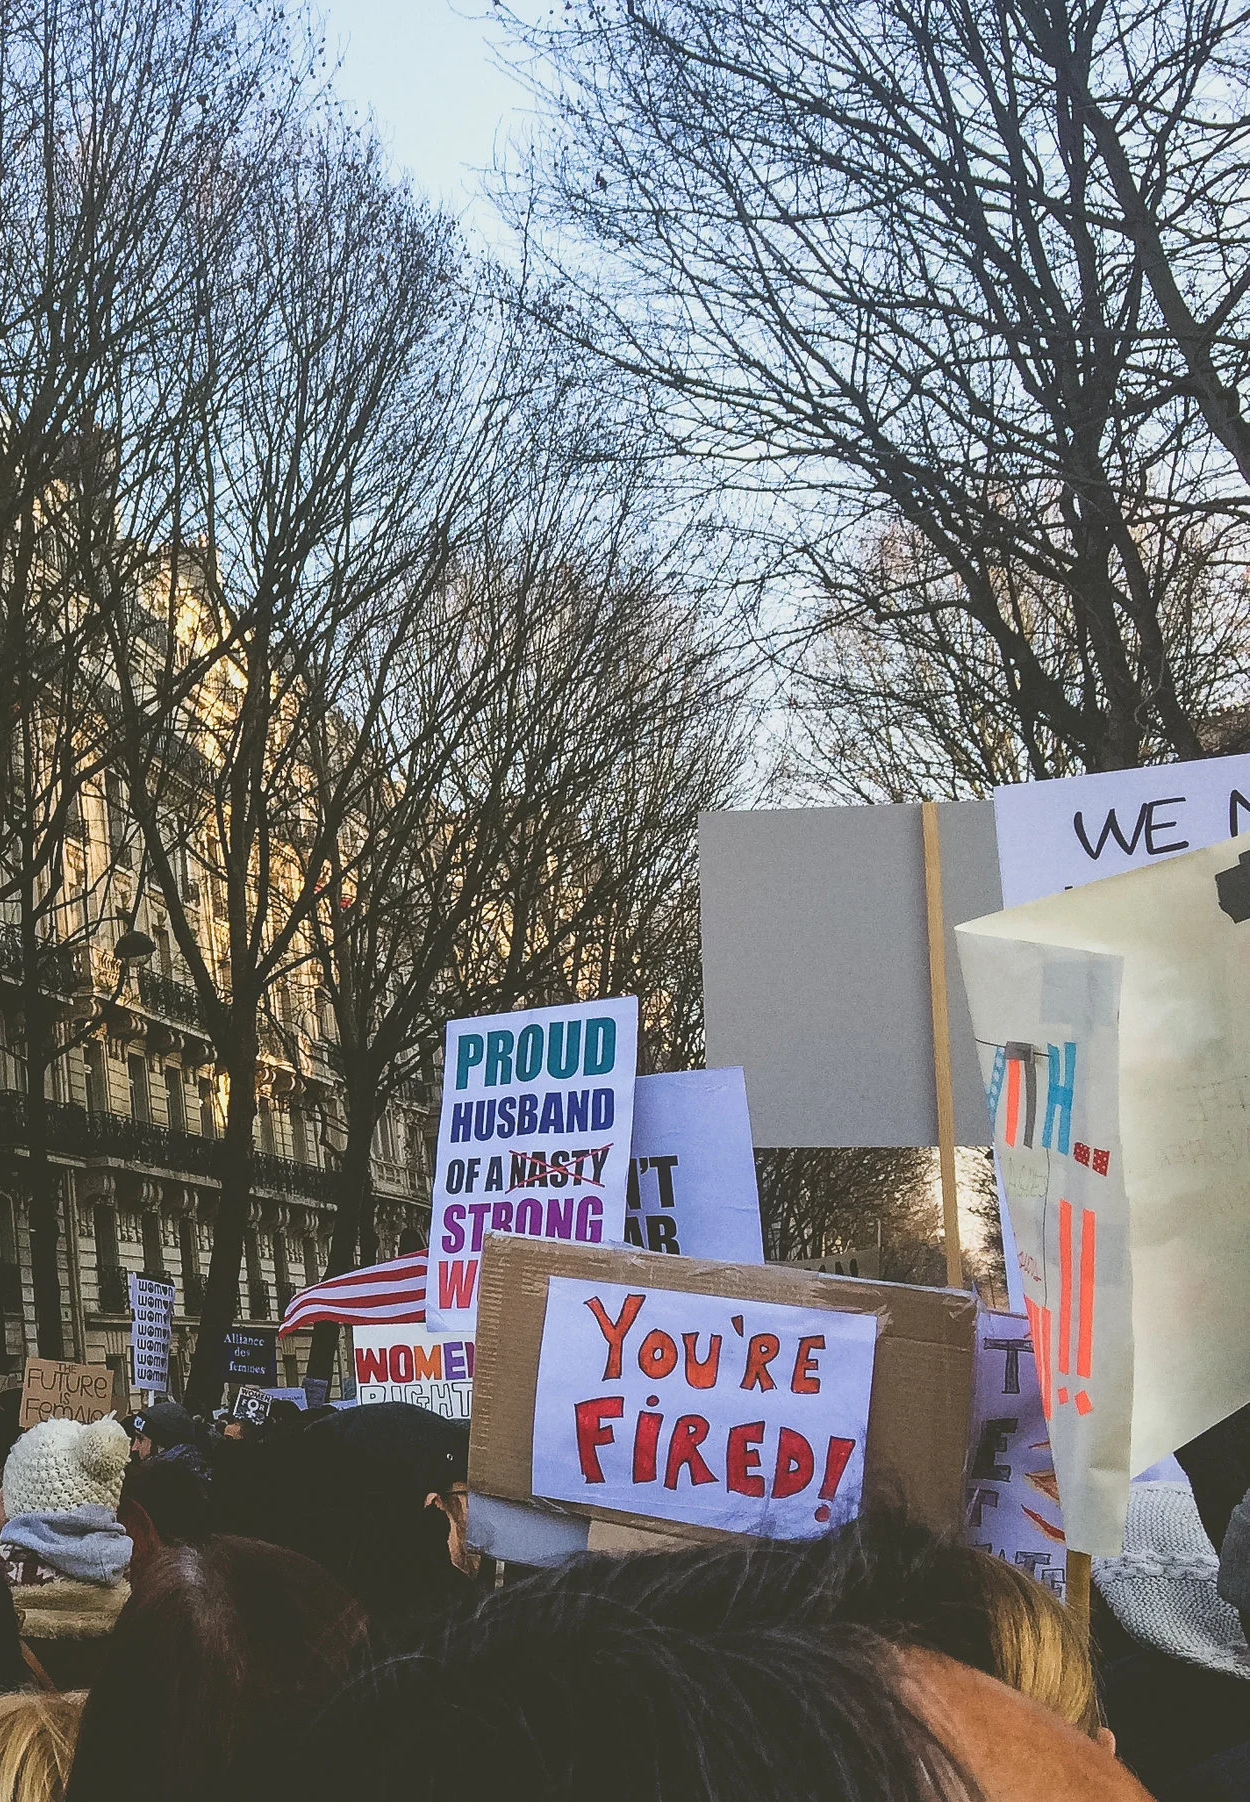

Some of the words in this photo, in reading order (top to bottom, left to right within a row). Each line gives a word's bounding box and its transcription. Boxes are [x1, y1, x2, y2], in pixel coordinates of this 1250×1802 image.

[1074, 797, 1188, 860] WE
[455, 1017, 617, 1090] PROUD
[450, 1087, 615, 1143] HUSBAND
[446, 1157, 481, 1195] OF
[484, 1156, 503, 1192] A
[508, 1148, 611, 1192] NASTY
[442, 1196, 604, 1254] STRONG
[438, 1259, 479, 1309] W
[224, 1333, 265, 1346] Alliance
[234, 1347, 251, 1357] des
[584, 1294, 826, 1394] YOU'RE
[57, 1363, 77, 1374] THE
[229, 1360, 266, 1375] femmes
[60, 1392, 71, 1406] IS
[241, 1387, 272, 1403] WOMEN
